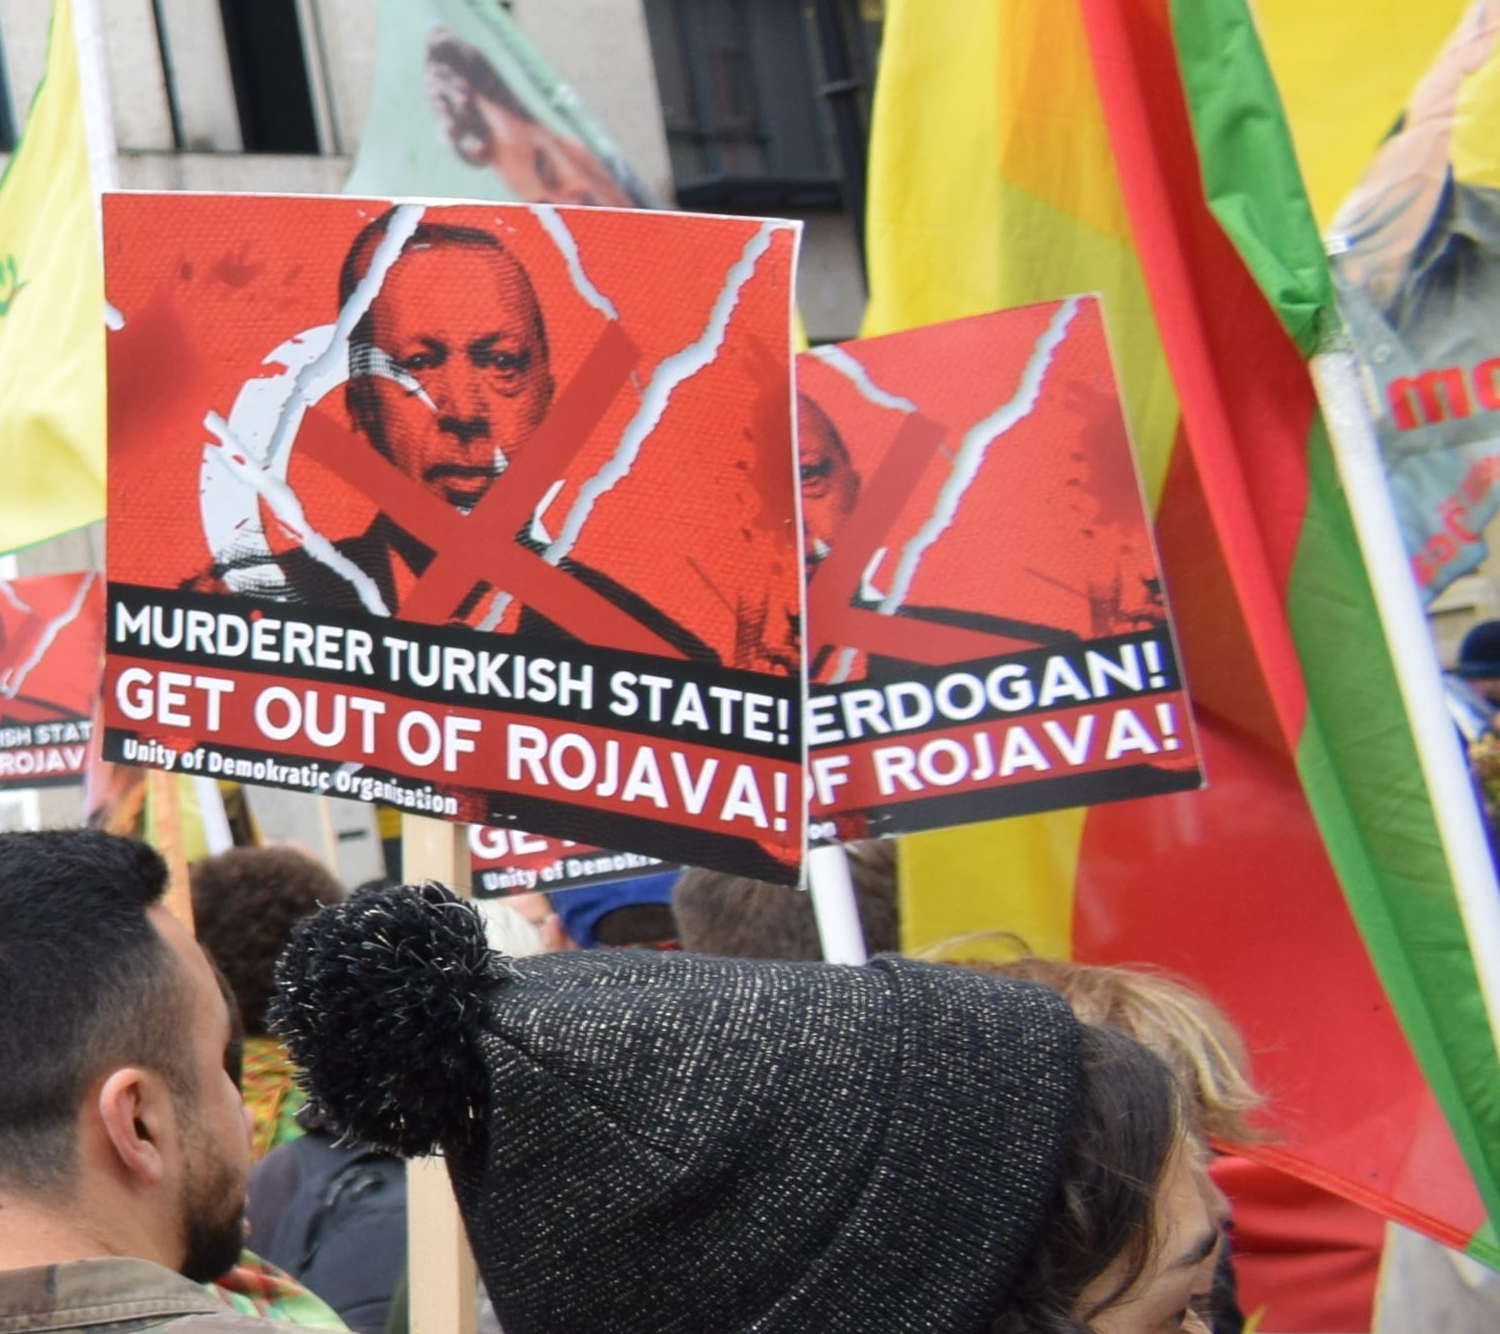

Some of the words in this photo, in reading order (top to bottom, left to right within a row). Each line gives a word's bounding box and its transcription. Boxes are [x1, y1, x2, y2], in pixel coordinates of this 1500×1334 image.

[115, 602, 374, 675] MURDERER
[382, 636, 594, 710] TURKISH
[609, 670, 790, 746] STATE!
[807, 640, 1168, 746] ERDOGAN!
[115, 667, 235, 732] GET
[254, 685, 386, 754] OUT
[397, 709, 482, 772] OF
[506, 723, 788, 832] ROJAVA!
[122, 738, 176, 770] Unity
[182, 748, 205, 770] of
[209, 751, 330, 790] Demokratic
[336, 771, 458, 816] Organisation
[807, 754, 852, 806] F
[872, 703, 1182, 796] ROJAVA!
[468, 824, 576, 860] GE
[482, 867, 538, 891] Unity
[541, 860, 564, 882] of
